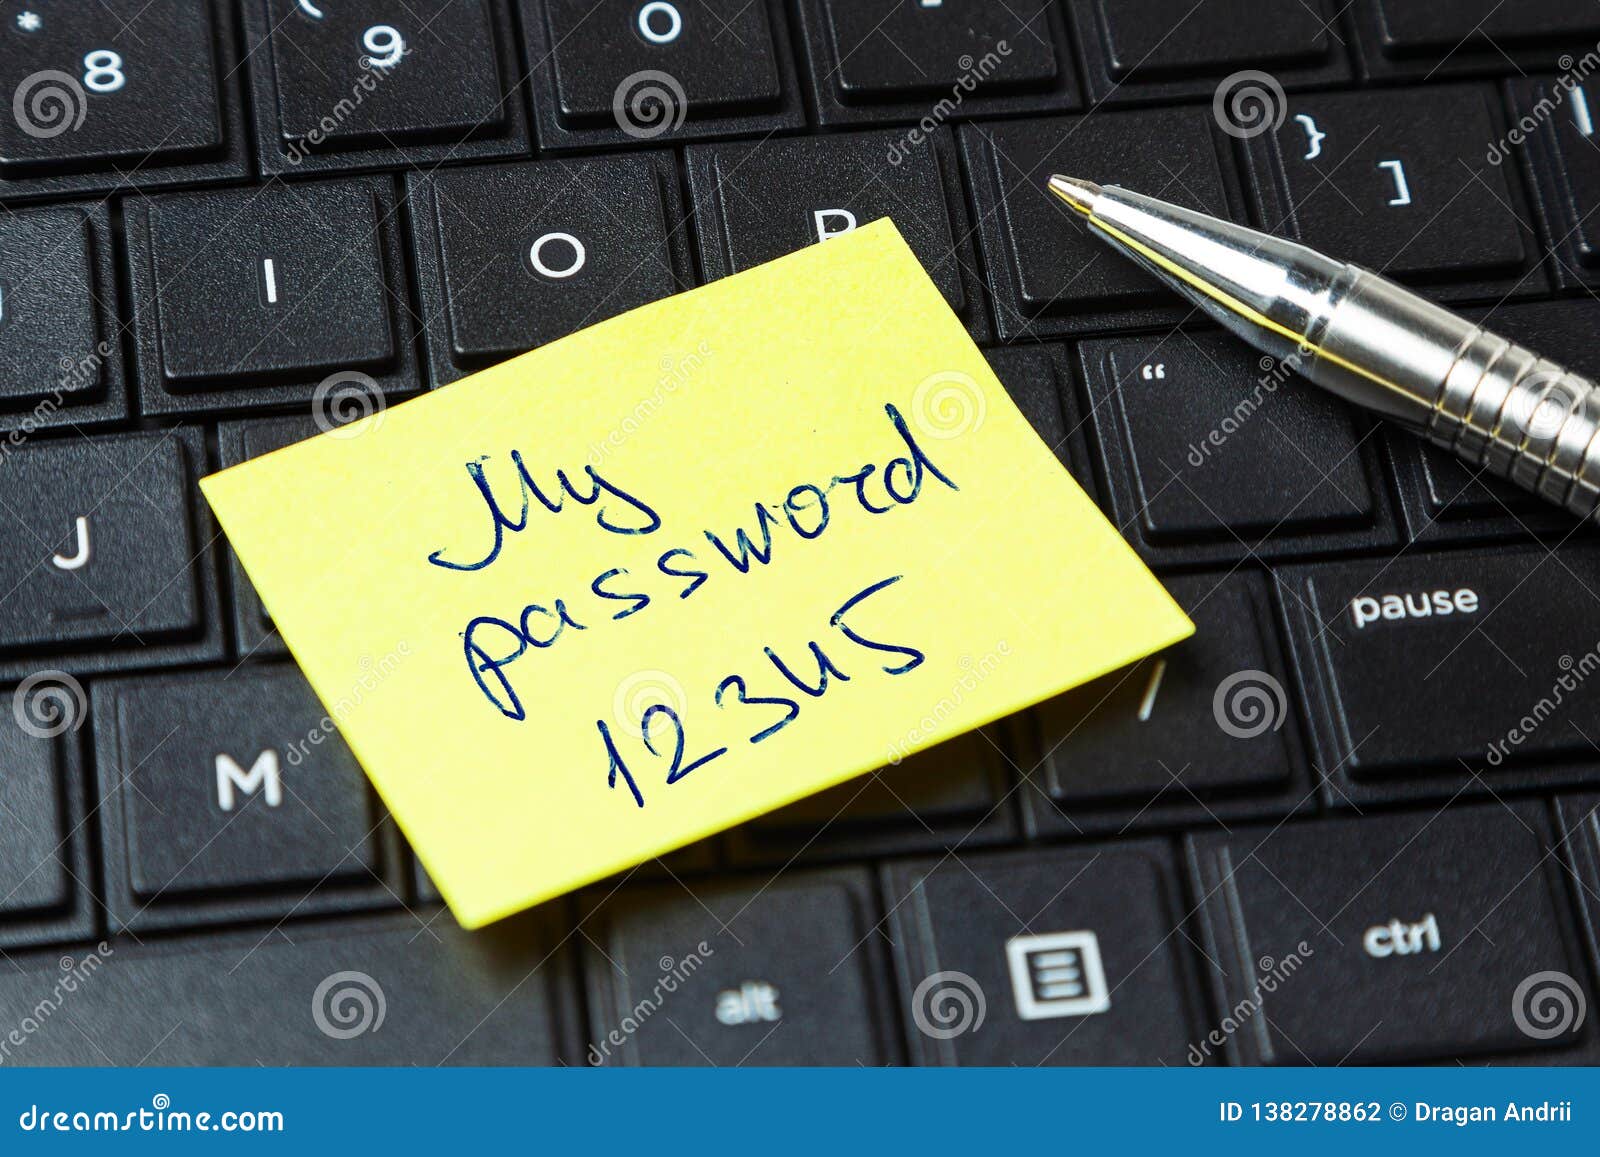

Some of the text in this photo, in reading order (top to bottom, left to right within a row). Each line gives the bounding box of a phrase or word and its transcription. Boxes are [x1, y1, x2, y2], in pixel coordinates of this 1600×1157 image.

[363, 25, 403, 67] 9
[83, 49, 126, 92] 8
[530, 232, 586, 279] O
[428, 450, 661, 571] My
[53, 516, 90, 570] J
[460, 403, 959, 721] password
[1351, 588, 1479, 629] pause
[215, 749, 281, 811] M
[1363, 912, 1441, 958] ctrl
[715, 981, 783, 1025] alt
